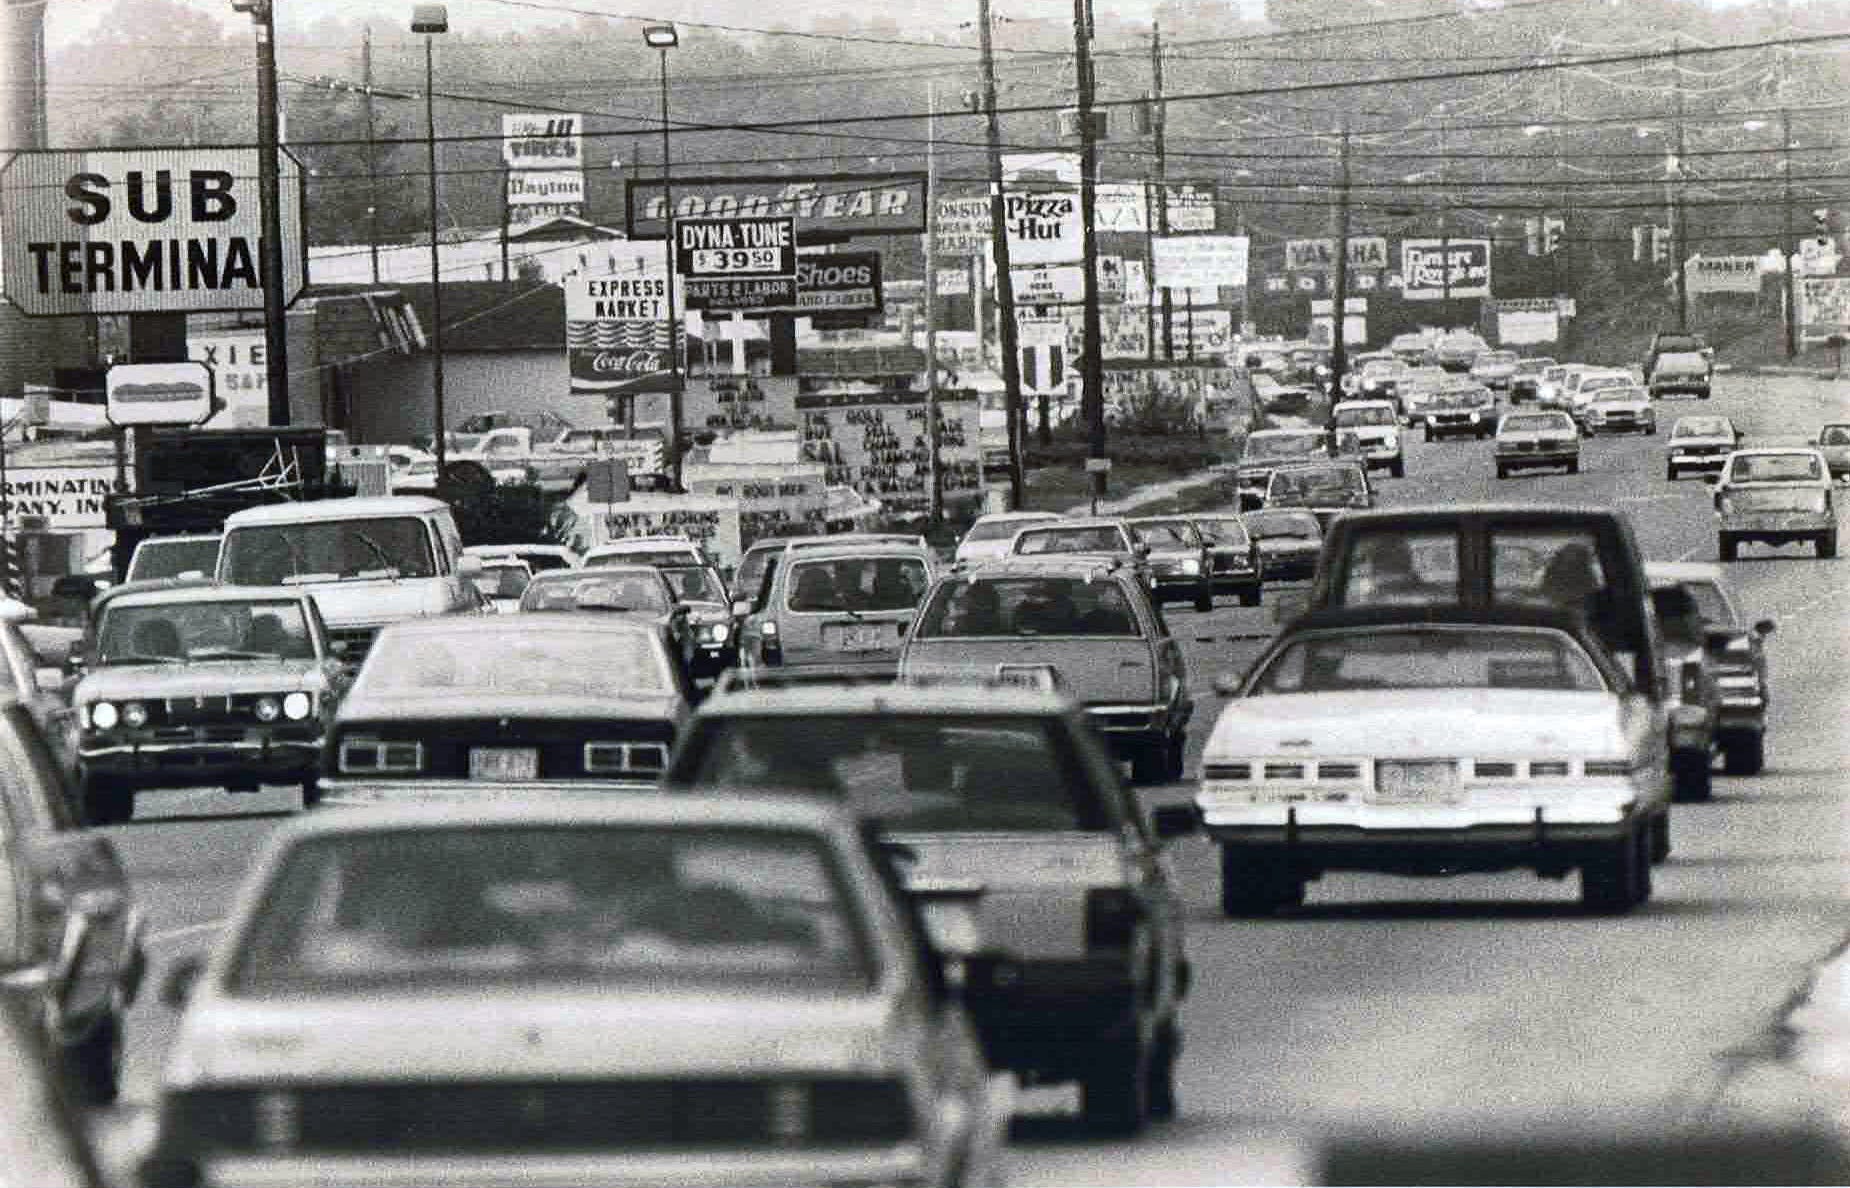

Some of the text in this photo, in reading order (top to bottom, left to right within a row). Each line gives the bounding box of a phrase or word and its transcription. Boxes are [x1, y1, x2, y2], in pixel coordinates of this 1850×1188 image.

[65, 170, 237, 225] SUB
[1005, 193, 1073, 220] Pizza
[682, 221, 791, 250] DYNA-TUNE
[1009, 217, 1062, 240] Hut
[798, 263, 871, 287] Shoes
[588, 279, 664, 297] EXPRESS
[595, 299, 660, 318] MARKET
